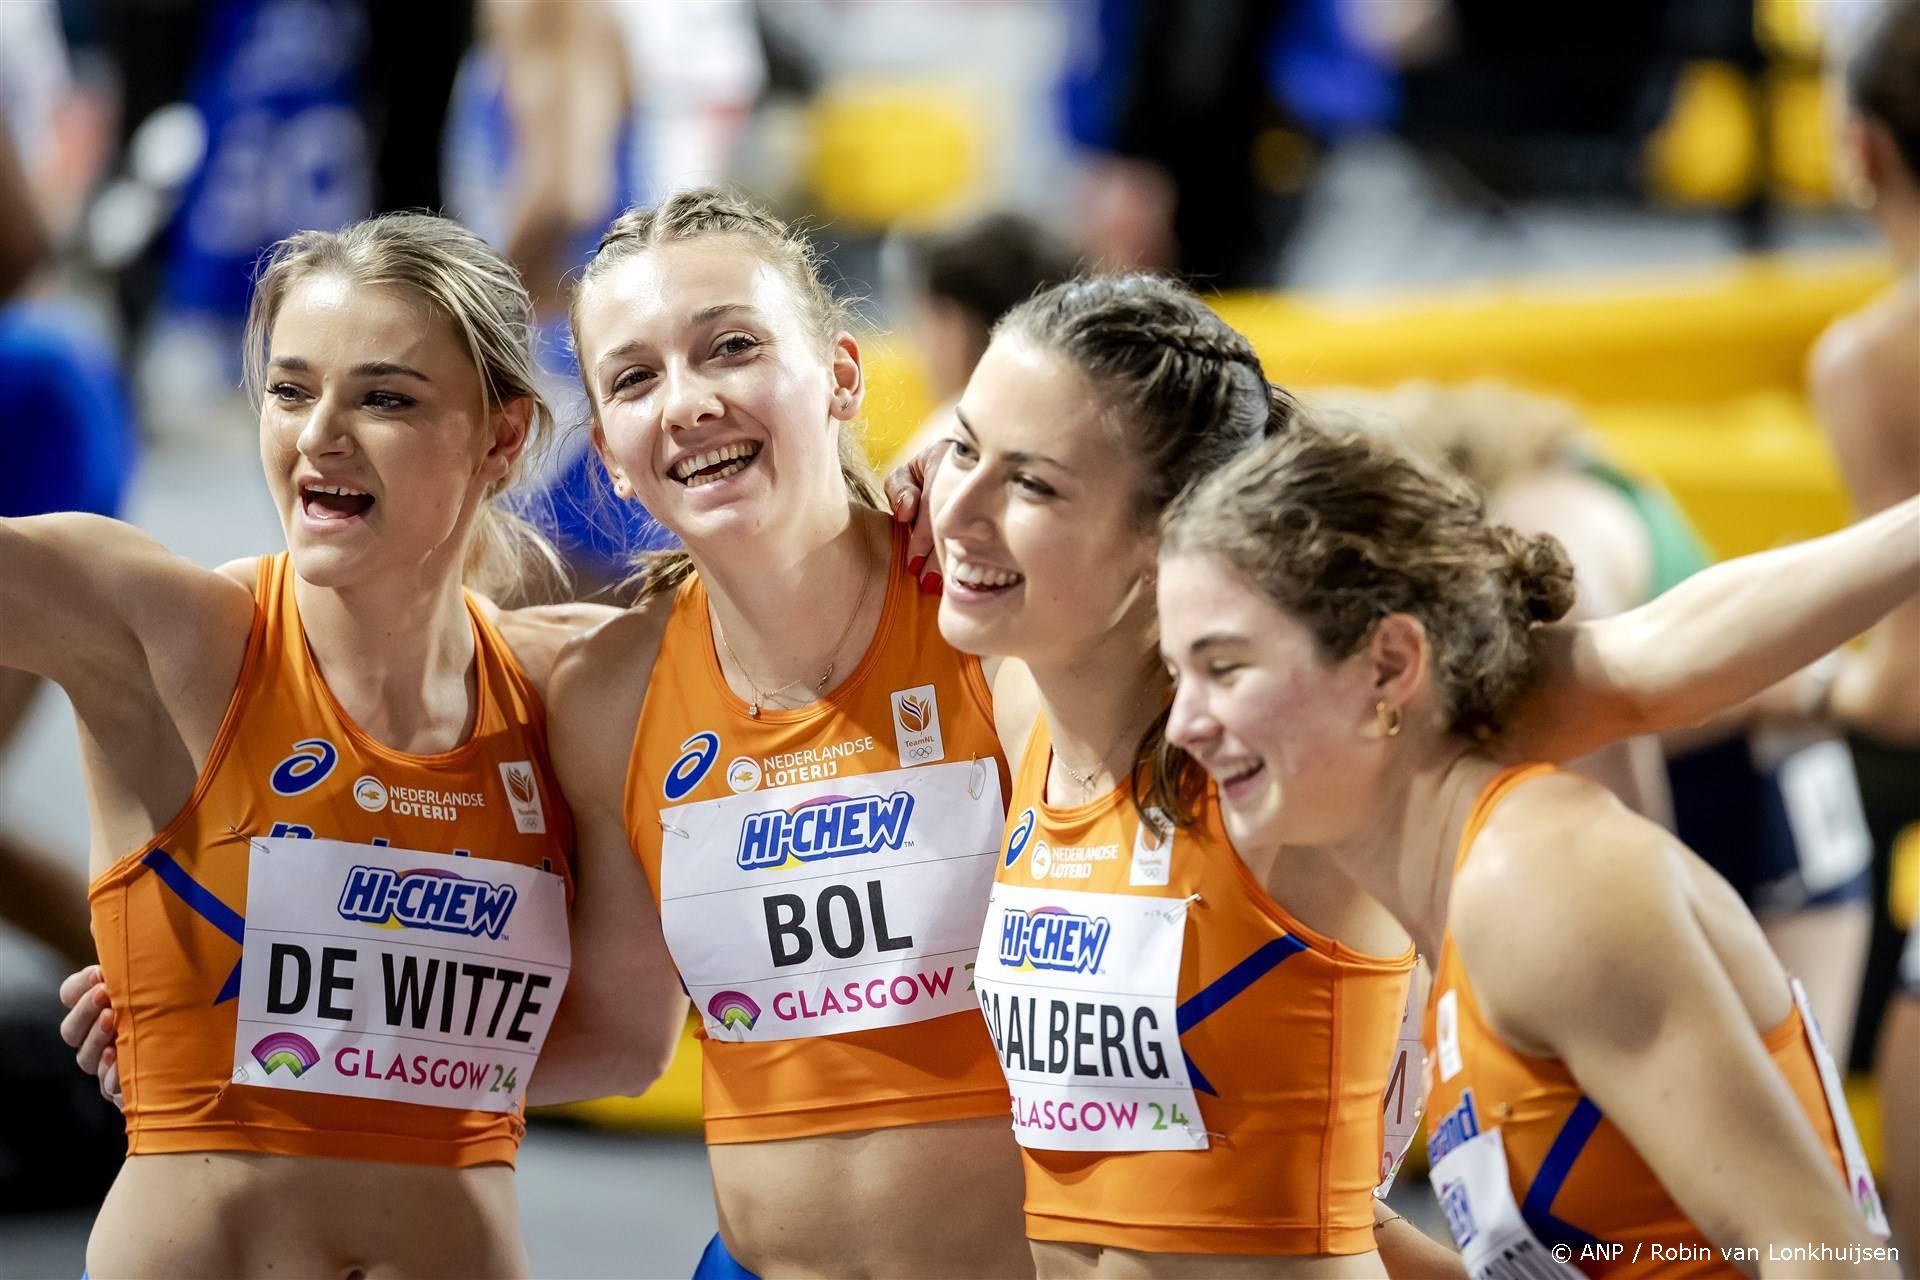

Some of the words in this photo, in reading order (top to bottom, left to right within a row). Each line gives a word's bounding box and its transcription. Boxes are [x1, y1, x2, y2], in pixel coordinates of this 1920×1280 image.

[764, 736, 875, 770] NEDERLANDSE
[904, 736, 935, 748] TeamNL
[765, 763, 838, 788] LOTERIJ
[389, 785, 485, 808] NEDERLANDSE
[391, 801, 457, 822] LOTERIJ
[736, 791, 915, 871] HI-CHEW
[1053, 844, 1119, 861] NEDERLANDSE
[338, 865, 517, 939] HI-CHEW
[763, 880, 914, 968] BOL
[999, 908, 1111, 975] HI-CHEW
[266, 943, 357, 1022] DE
[381, 952, 552, 1043] WITTE
[773, 966, 954, 1021] GLASGOW
[334, 1048, 491, 1091] GLASGOW
[489, 1065, 517, 1094] 24
[1150, 1103, 1189, 1131] 24
